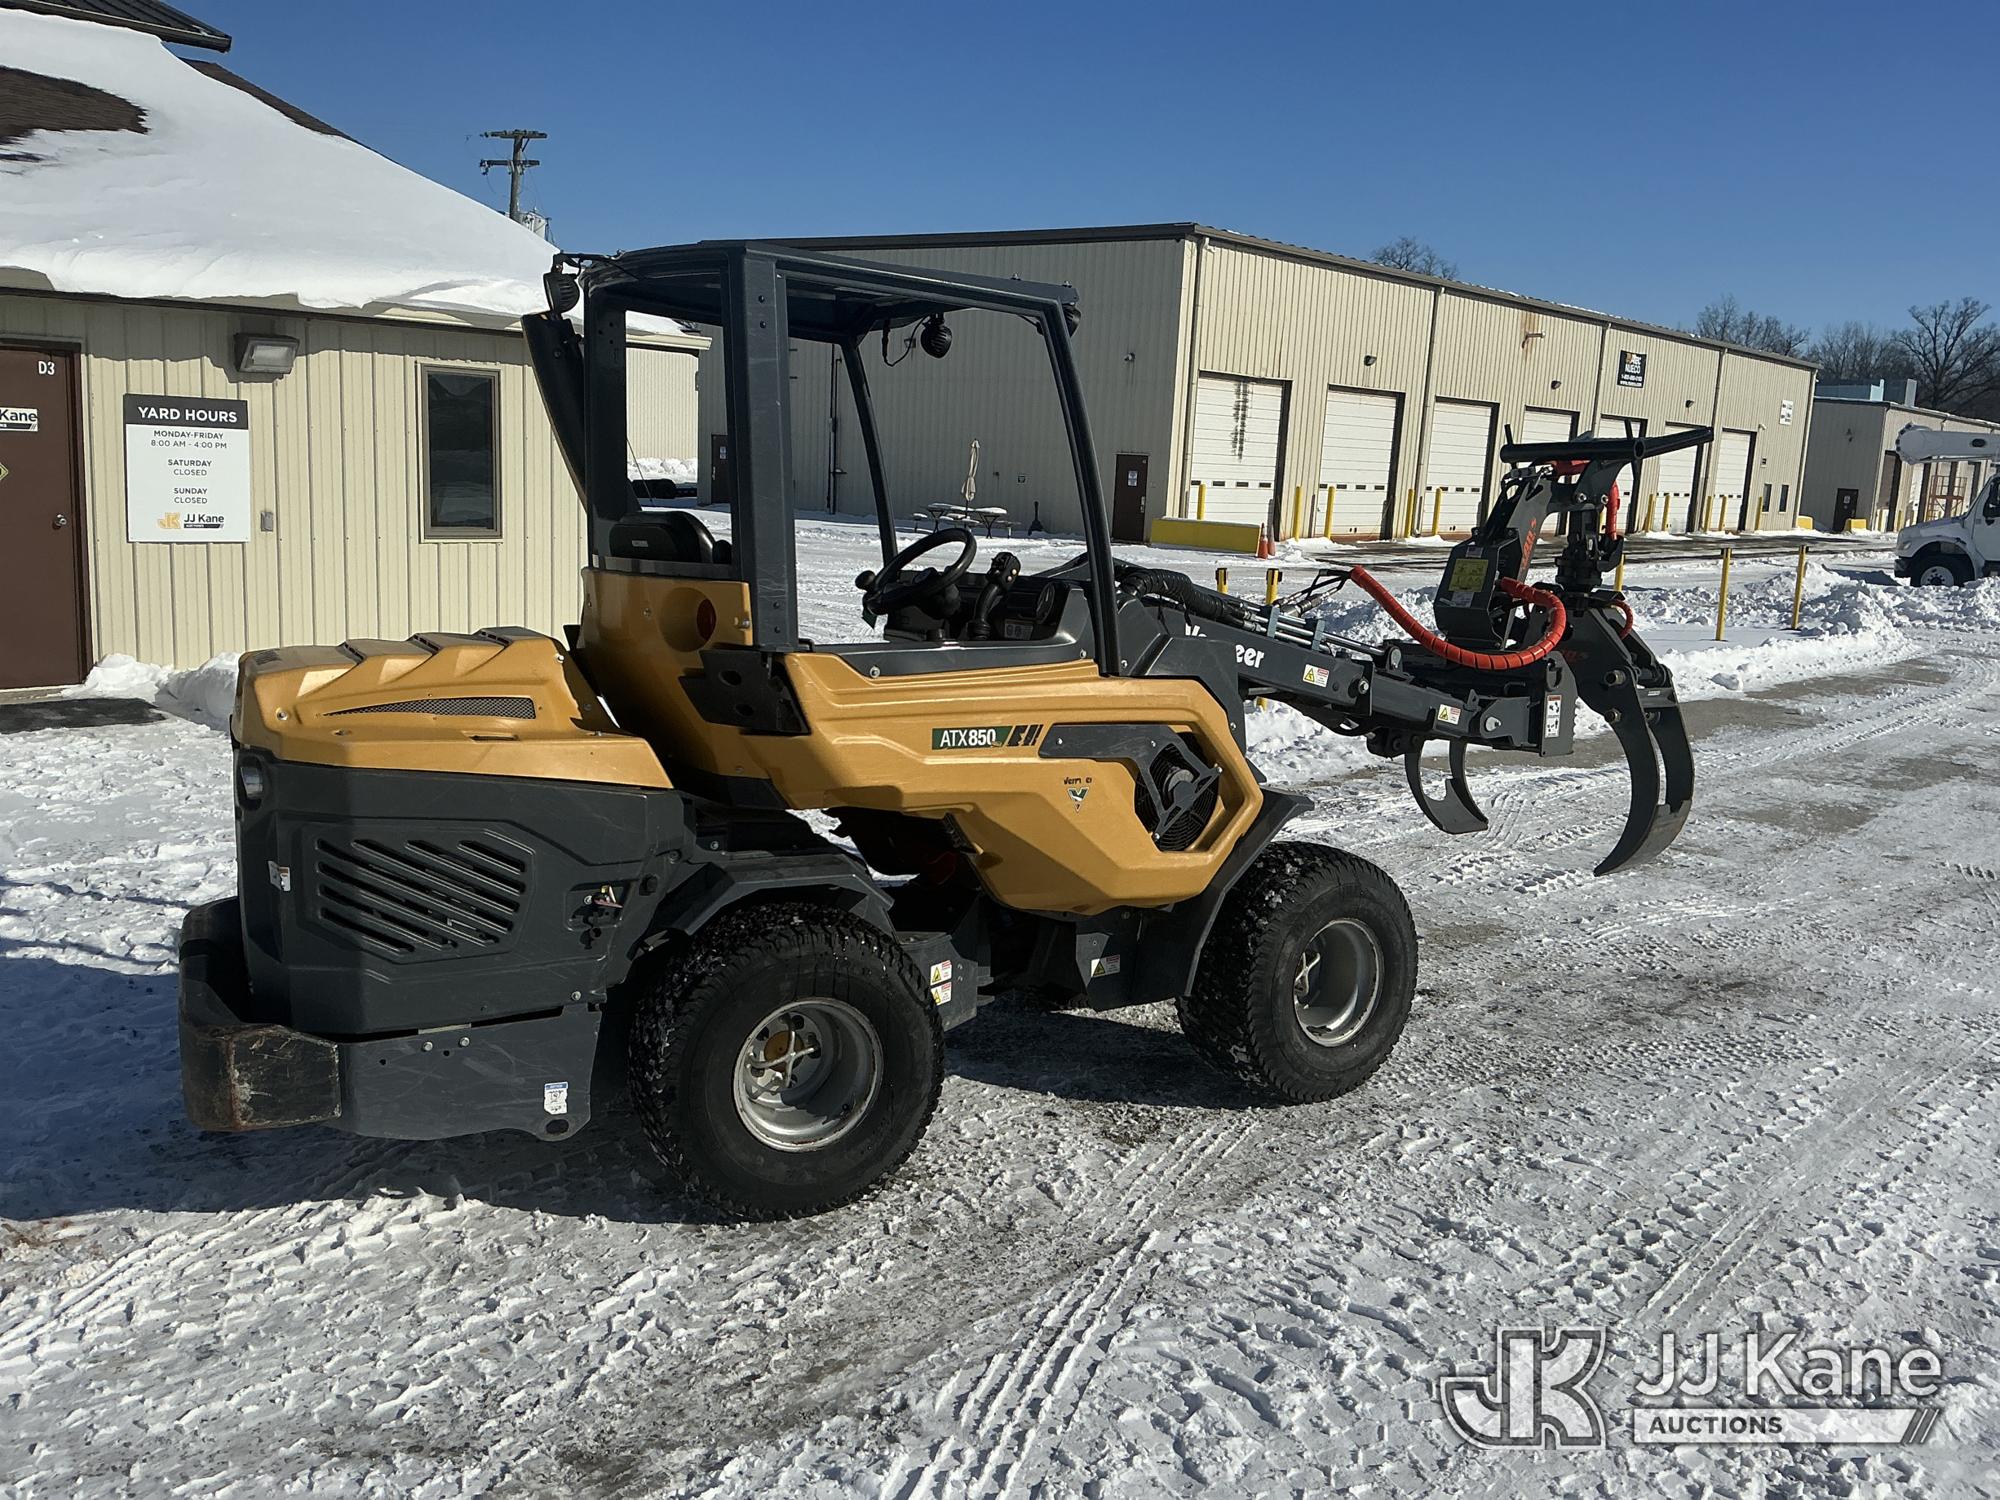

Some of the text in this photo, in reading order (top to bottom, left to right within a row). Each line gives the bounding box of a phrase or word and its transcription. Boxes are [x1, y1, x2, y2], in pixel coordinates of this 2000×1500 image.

[38, 360, 55, 375] D3
[0, 408, 38, 422] Kane
[138, 406, 238, 423] YARD HOURS
[153, 430, 224, 440] MONDAY-FRIDAY
[151, 439, 170, 447] 8:00
[172, 440, 186, 448] AM
[194, 441, 213, 449] 4:00
[168, 458, 212, 467] SATURDAY
[173, 468, 207, 476] CLOSED
[173, 487, 208, 495] SUNDAY
[174, 496, 208, 504] CLOSED
[183, 513, 225, 523] JJ Kane
[940, 728, 997, 747] ATX850
